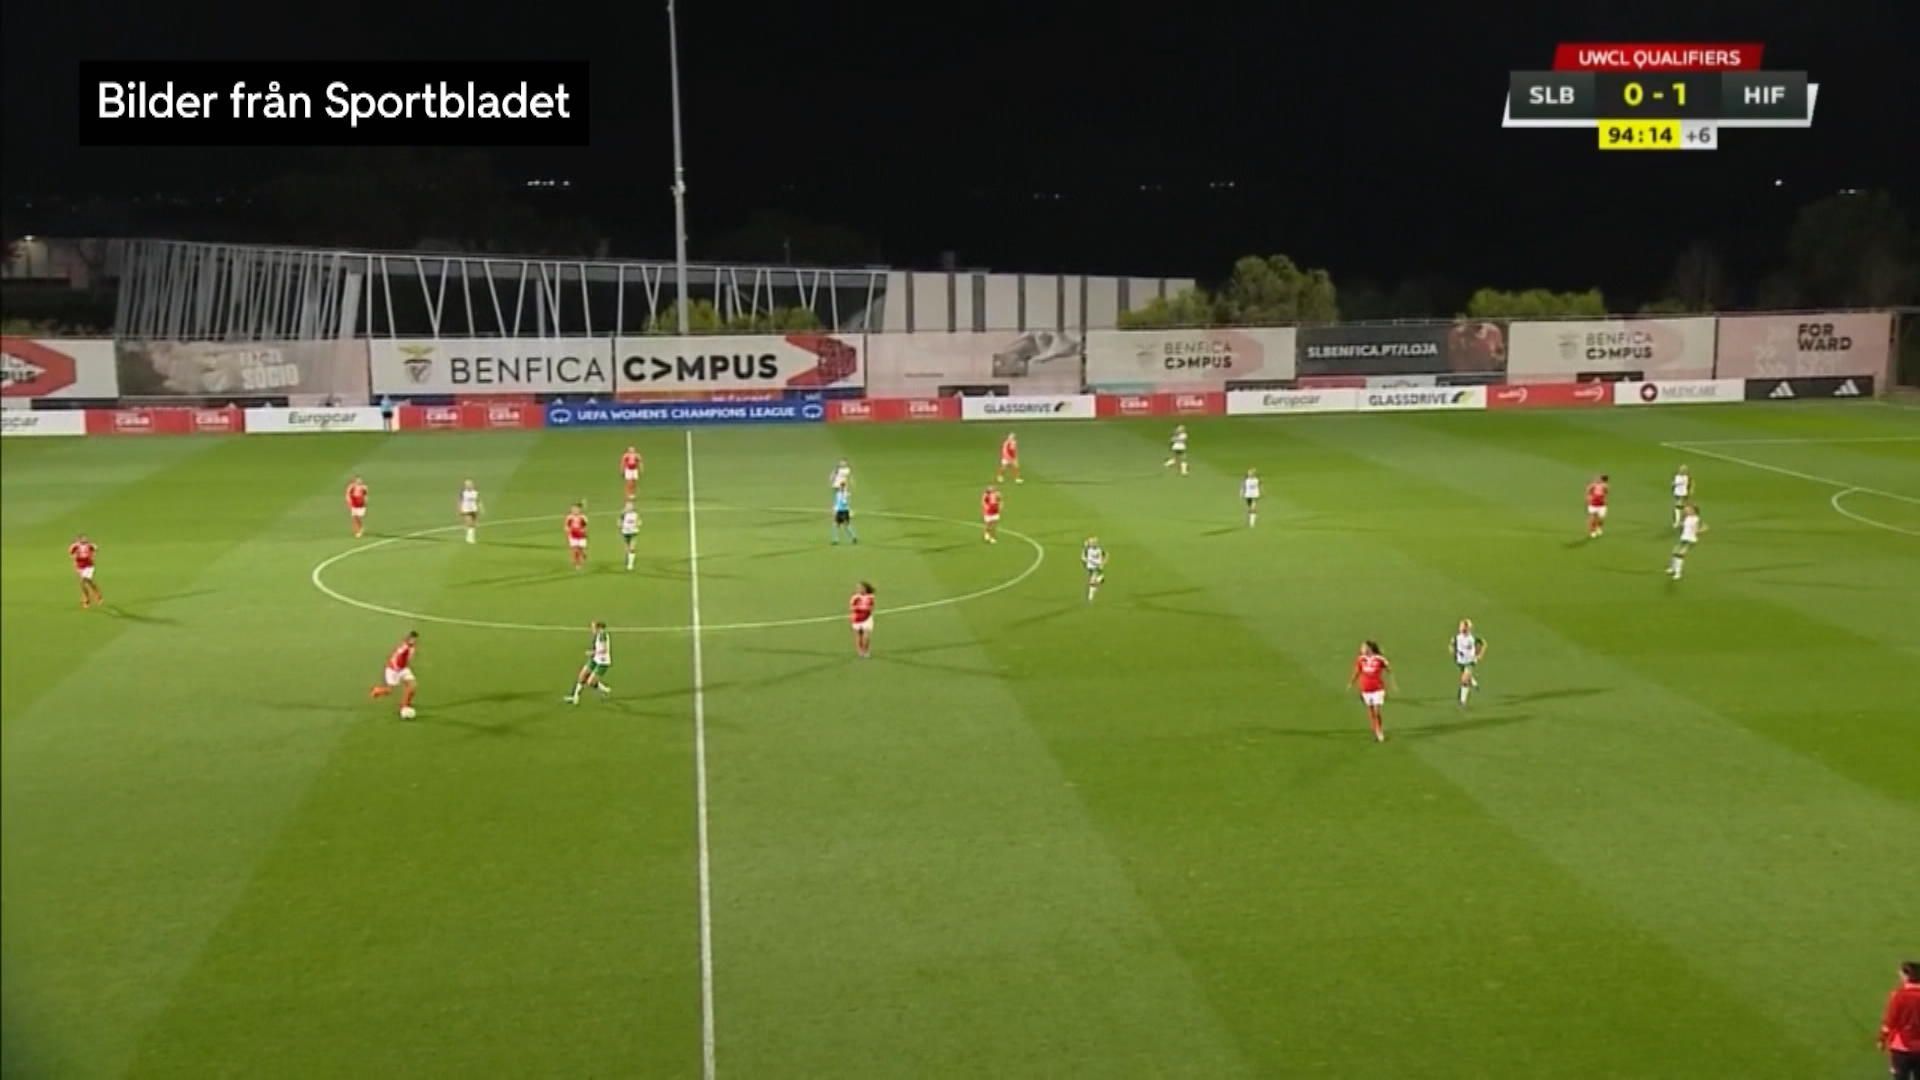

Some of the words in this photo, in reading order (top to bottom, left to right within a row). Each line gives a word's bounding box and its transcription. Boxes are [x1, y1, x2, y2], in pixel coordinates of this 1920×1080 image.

[1798, 322, 1835, 338] FOR
[1586, 331, 1653, 346] BENFICA
[1798, 337, 1853, 352] WARD
[1164, 340, 1233, 354] BENFICA
[1307, 343, 1438, 359] SLBENFICA.PT/LOJA
[450, 356, 606, 385] BENFICA
[1262, 393, 1321, 409] Europcar
[1367, 392, 1447, 407] GLASSDRIVE
[577, 409, 609, 421] UEFA
[610, 408, 668, 420] WOMEN'S
[670, 406, 747, 419] CHAMPIONS
[749, 405, 796, 417] LEAGUE
[983, 402, 1051, 414] GLASSDRIVE
[287, 411, 357, 426] Europcar
